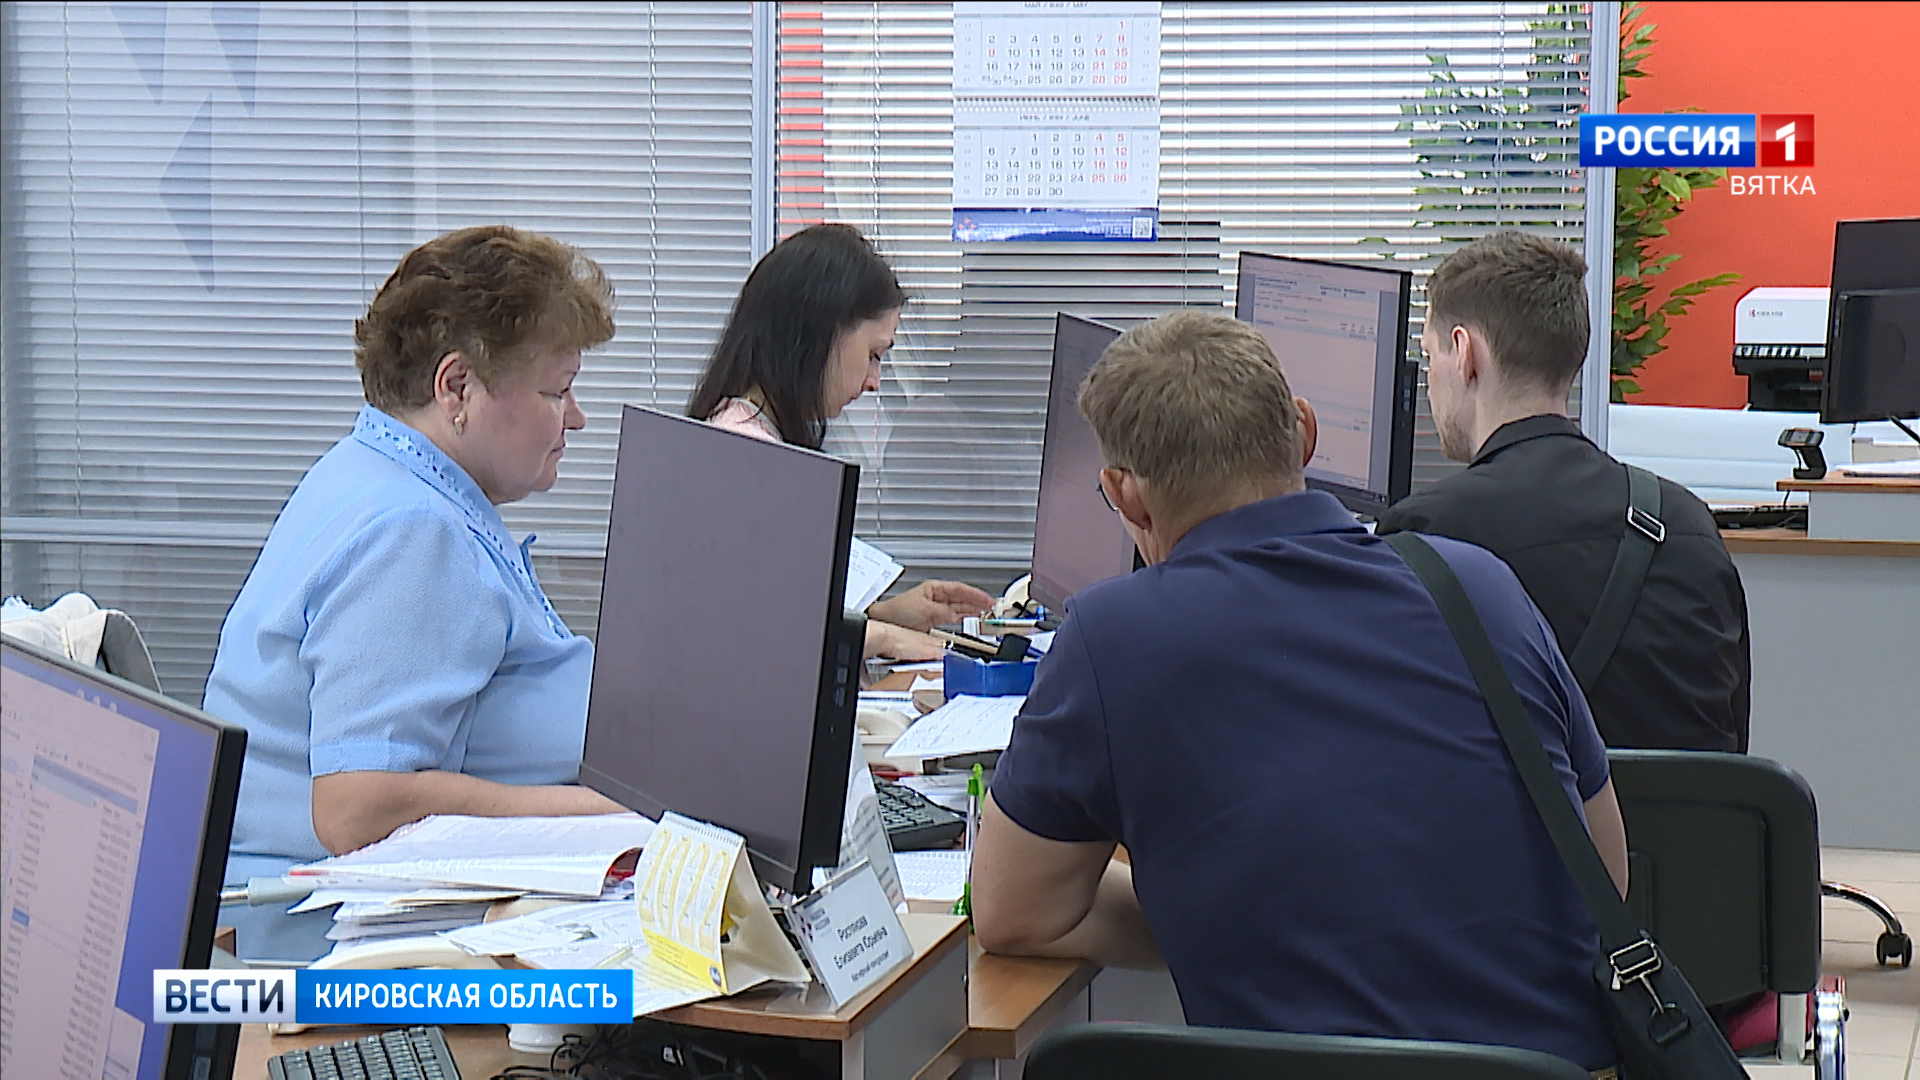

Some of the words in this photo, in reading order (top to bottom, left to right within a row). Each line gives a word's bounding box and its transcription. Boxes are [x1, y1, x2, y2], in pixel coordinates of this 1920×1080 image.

[1119, 21, 1124, 30] 1
[988, 35, 996, 44] 2
[1009, 35, 1017, 44] 3
[1031, 35, 1039, 44] 4
[1052, 35, 1060, 44] 5
[1074, 35, 1082, 44] 6
[1096, 35, 1103, 44] 7
[1007, 48, 1020, 58] 10
[1029, 48, 1040, 58] 11
[1050, 48, 1062, 58] 12
[1072, 48, 1084, 58] 13
[1094, 48, 1105, 58] 14
[1115, 48, 1127, 58] 15
[986, 62, 998, 71] 16
[1007, 62, 1019, 71] 17
[1029, 62, 1041, 71] 18
[1050, 62, 1063, 71] 19
[1070, 62, 1084, 71] 20
[1092, 62, 1104, 71] 21
[1113, 62, 1127, 71] 22
[1032, 133, 1037, 142] 1
[1052, 133, 1060, 142] 2
[1095, 133, 1103, 142] 4
[1117, 133, 1125, 142] 5
[988, 147, 996, 156] 6
[1009, 147, 1017, 156] 7
[1031, 147, 1039, 156] 8
[1072, 147, 1084, 156] 10
[1093, 147, 1104, 156] 11
[1115, 147, 1127, 156] 12
[986, 160, 998, 170] 13
[1007, 160, 1019, 170] 14
[1028, 160, 1041, 170] 15
[1050, 160, 1062, 170] 16
[1071, 160, 1083, 170] 17
[1093, 160, 1105, 170] 18
[1115, 160, 1127, 170] 19
